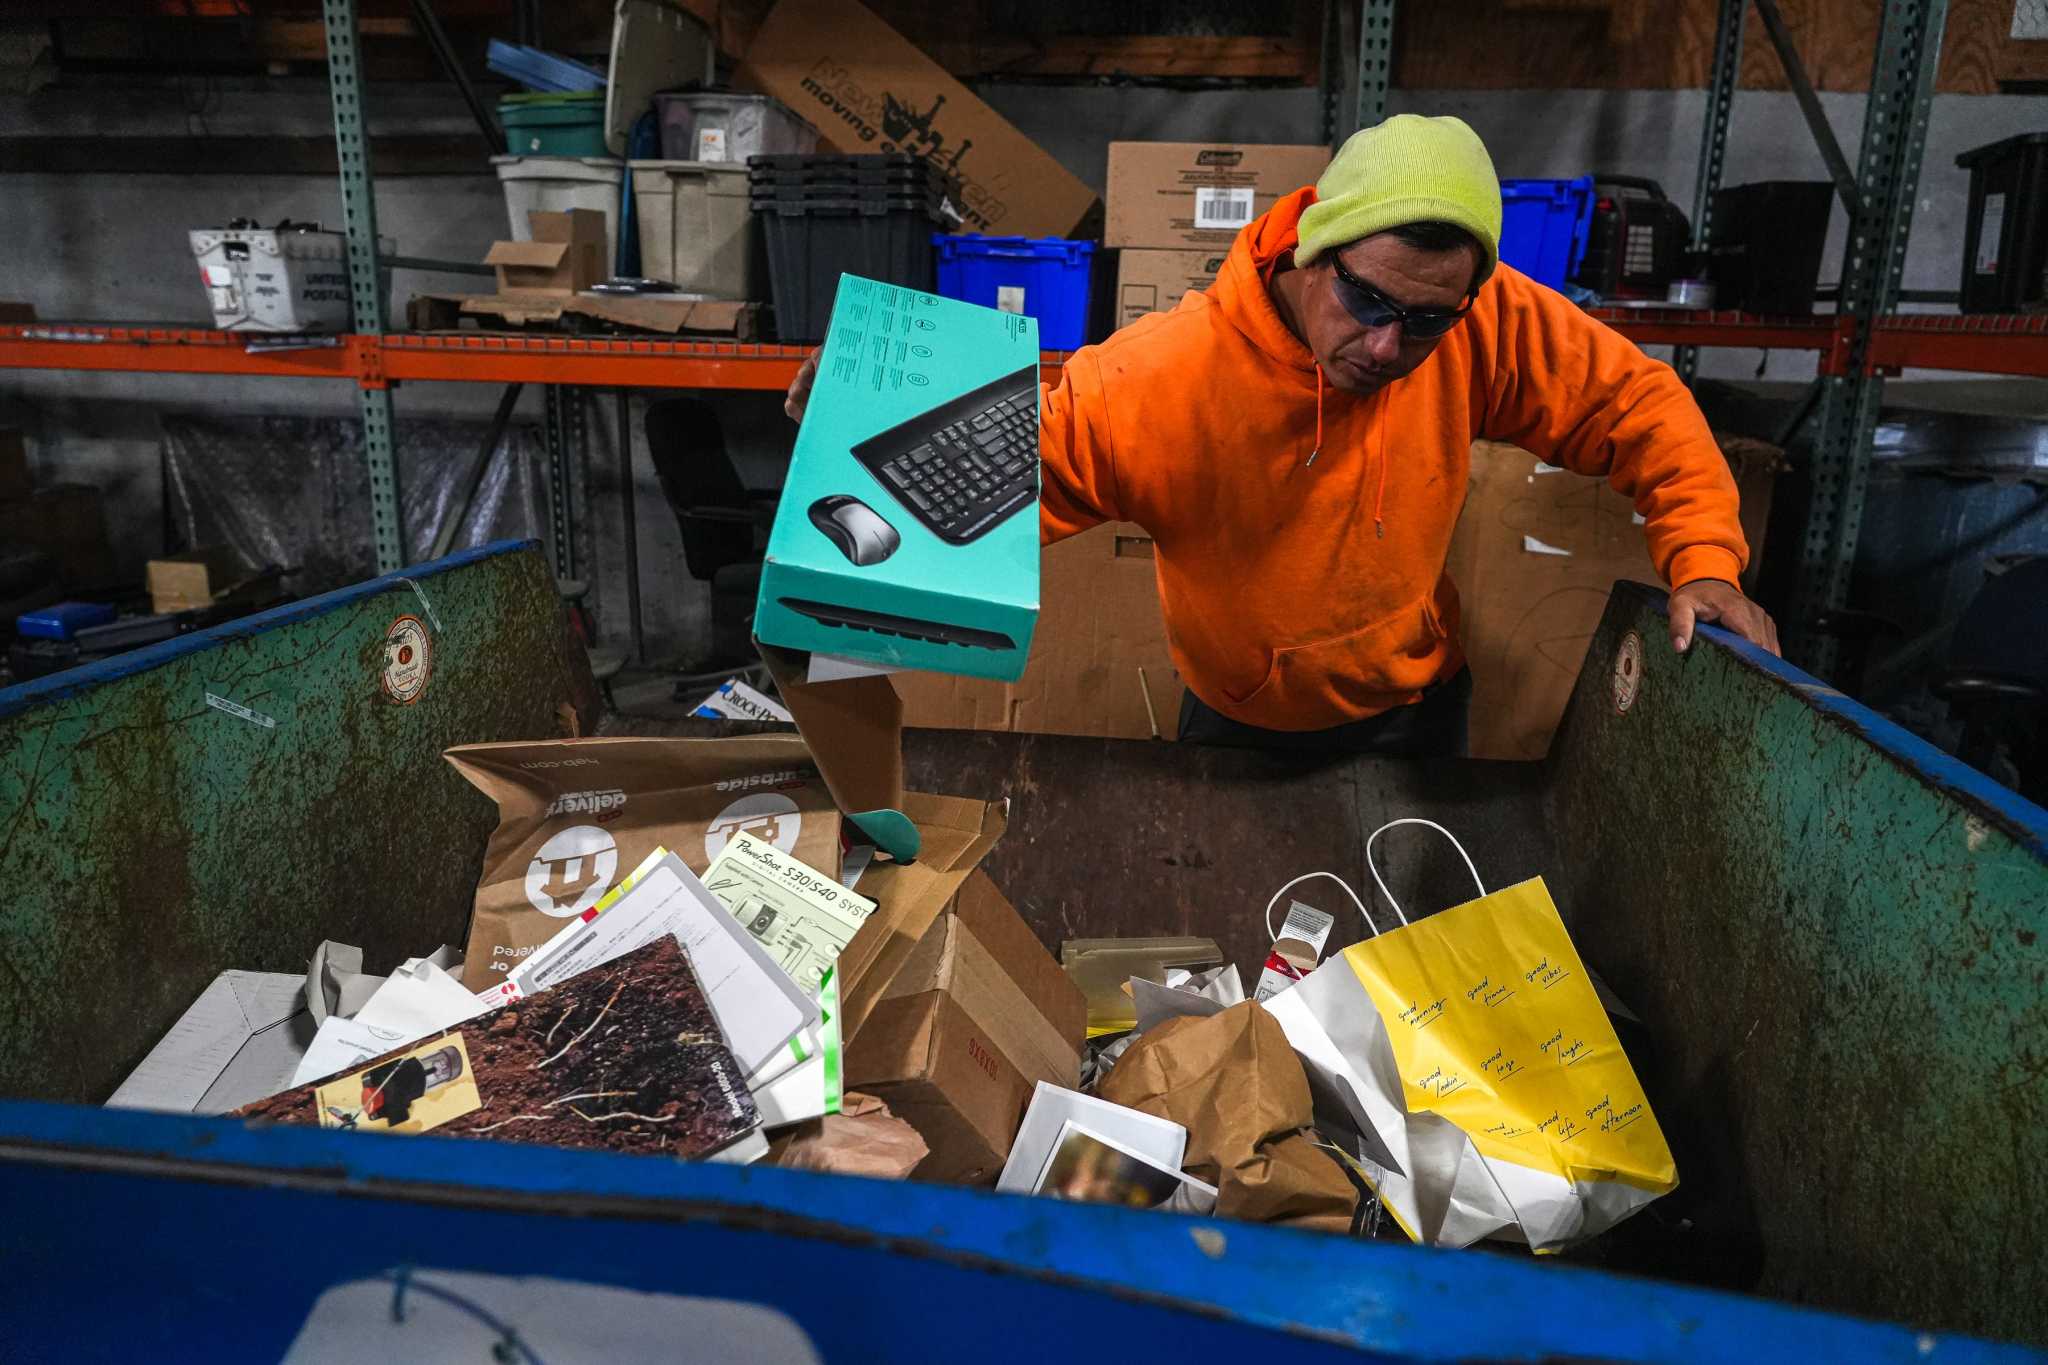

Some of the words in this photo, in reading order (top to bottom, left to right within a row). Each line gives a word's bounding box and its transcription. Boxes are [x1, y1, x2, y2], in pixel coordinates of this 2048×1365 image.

[800, 77, 877, 141] moving
[544, 793, 626, 819] delivery
[736, 839, 781, 871] PowerShot
[783, 866, 838, 902] S30/S40
[489, 961, 508, 971] or
[1526, 957, 1548, 982] good
[1543, 966, 1562, 983] vibes
[1467, 976, 1489, 1000] good
[1398, 1001, 1417, 1021] good
[1410, 998, 1447, 1026] morning
[1540, 1028, 1562, 1053] good
[1557, 1039, 1584, 1065] laughs
[1481, 1048, 1502, 1071] good
[1420, 1066, 1441, 1089] good
[1586, 1095, 1610, 1119] good
[1600, 1103, 1642, 1134] afternoon
[1537, 1110, 1560, 1133] good
[1558, 1117, 1576, 1138] life
